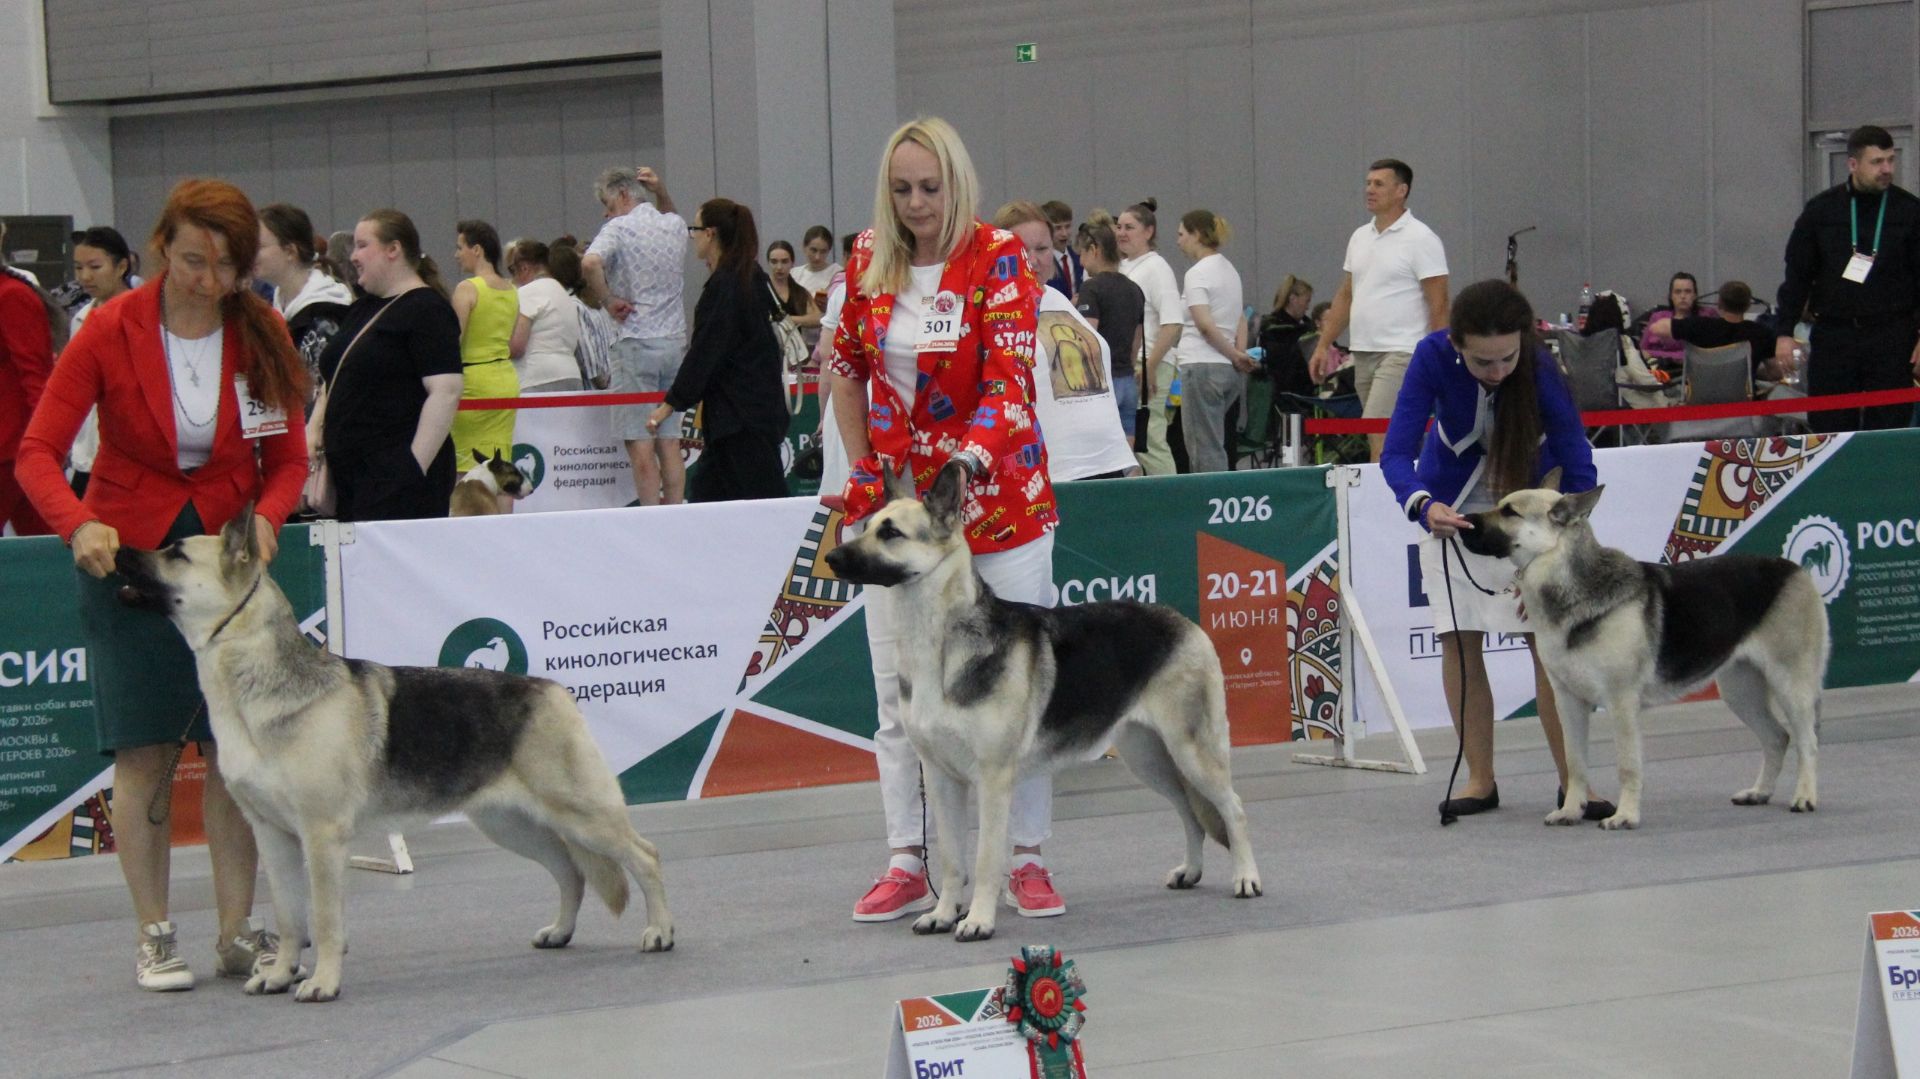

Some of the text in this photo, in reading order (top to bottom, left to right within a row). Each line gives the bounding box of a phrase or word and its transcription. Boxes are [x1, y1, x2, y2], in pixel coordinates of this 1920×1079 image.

[924, 320, 951, 333] 301
[994, 331, 1034, 346] STAY
[246, 400, 277, 416] 29
[553, 445, 617, 456] Российская
[553, 461, 631, 472] кинологическ
[553, 477, 616, 490] федерация
[1207, 495, 1272, 524] 2026
[1857, 518, 1920, 550] РОС
[1050, 574, 1156, 607] ССИЯ
[1206, 569, 1278, 600] 20-21
[1211, 608, 1278, 629] ИЮНЯ
[543, 617, 667, 640] Российская
[545, 644, 717, 671] кинологическая
[0, 647, 87, 688] СИЯ
[566, 678, 665, 703] дерация
[34, 699, 67, 711] собак
[51, 733, 60, 743] &
[1, 749, 42, 762] ГЕРОЕВ
[22, 784, 57, 796] пород
[1892, 926, 1920, 938] 2026
[915, 1015, 943, 1029] 2026
[914, 1059, 965, 1079] Брит
